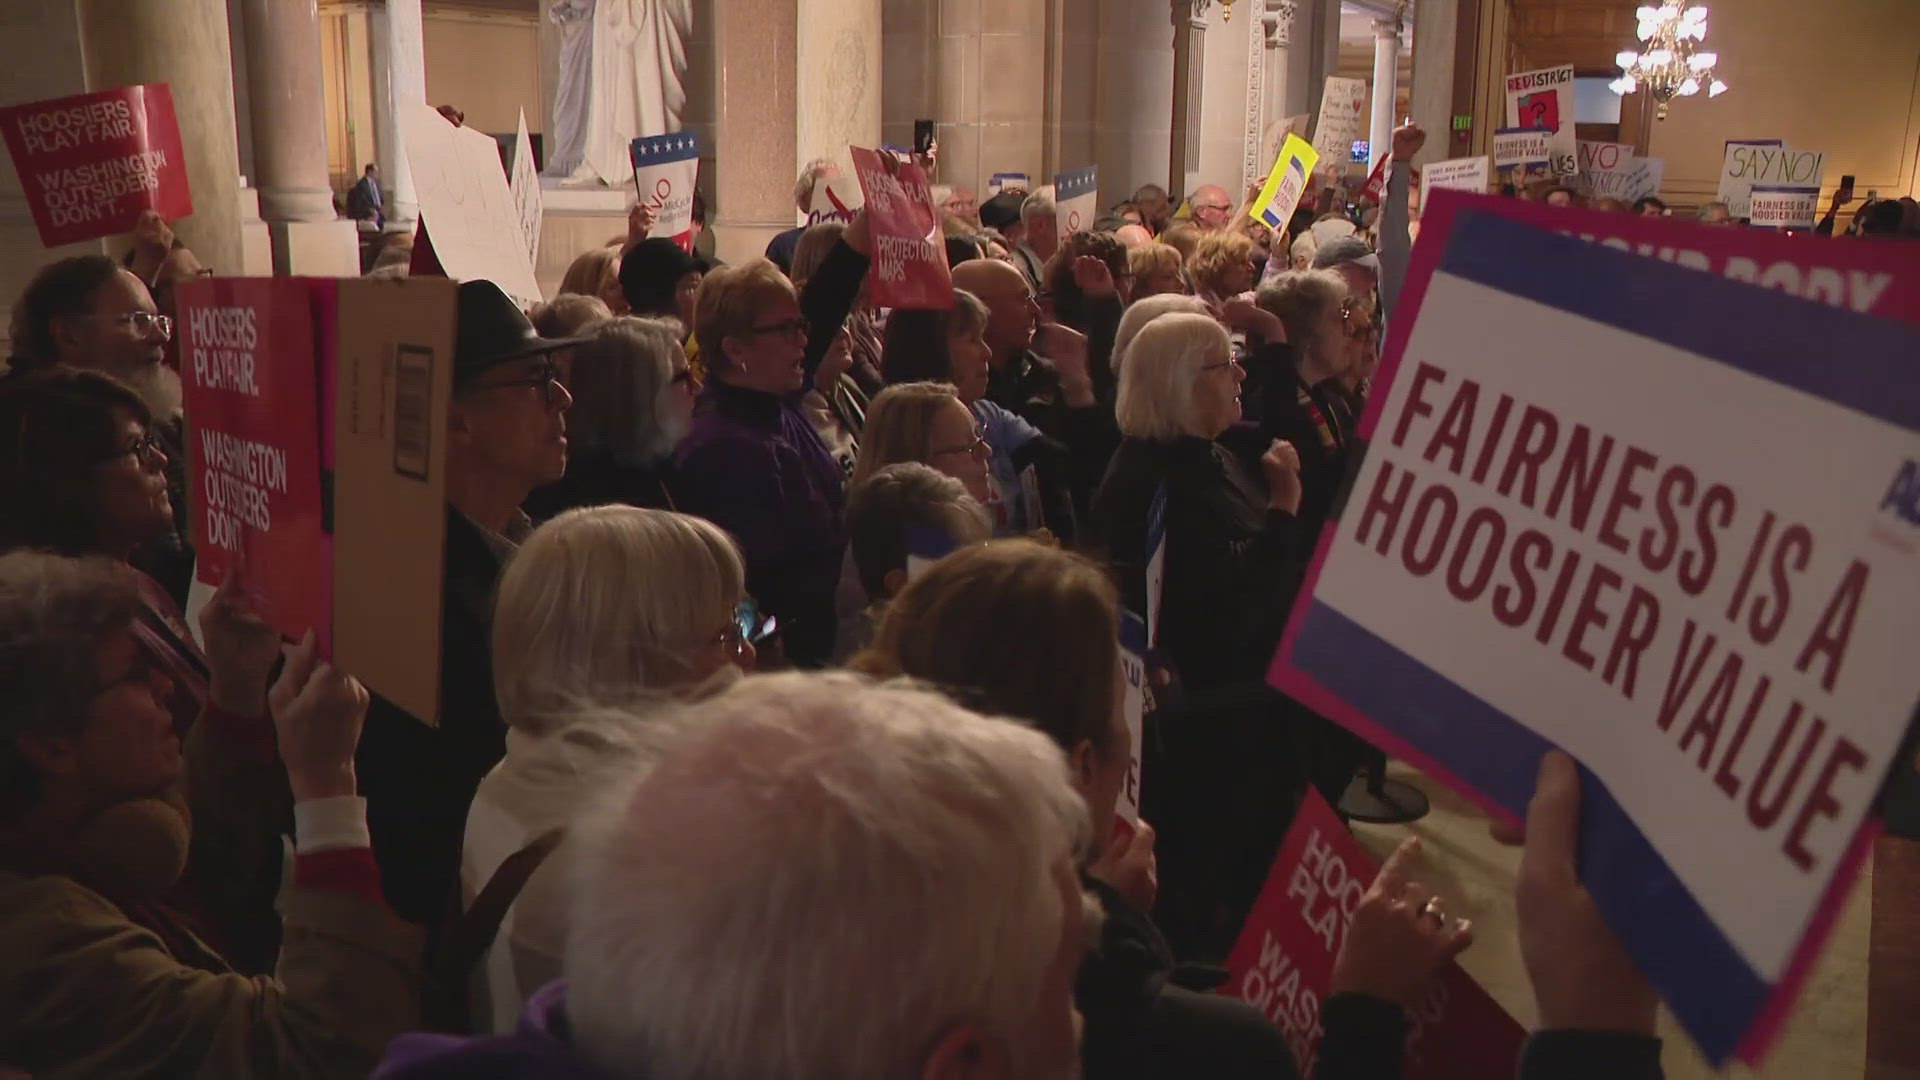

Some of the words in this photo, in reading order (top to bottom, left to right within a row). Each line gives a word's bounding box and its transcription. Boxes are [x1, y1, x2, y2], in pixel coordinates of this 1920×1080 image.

[1507, 68, 1573, 93] REDISTRICT
[17, 99, 130, 135] HOOSIERS
[1454, 116, 1472, 130] EXIT
[24, 127, 82, 155] PLAY
[86, 119, 137, 143] FAIR.
[37, 149, 167, 191] WASHINGTON
[1579, 143, 1618, 170] NO
[1729, 147, 1776, 179] SAY
[44, 170, 158, 208] OUTSIDERS
[1752, 200, 1794, 210] FAIRNESS
[1752, 210, 1791, 220] HOOSIER
[877, 234, 919, 261] PROTECT
[193, 347, 227, 389] PLAY
[1390, 361, 1736, 597] FAIRNESS
[1725, 510, 1813, 645] IS
[1795, 558, 1871, 694] A
[1354, 460, 1661, 700] HOOSIER
[1656, 619, 1870, 874] VALUE
[1288, 863, 1343, 951] PLA
